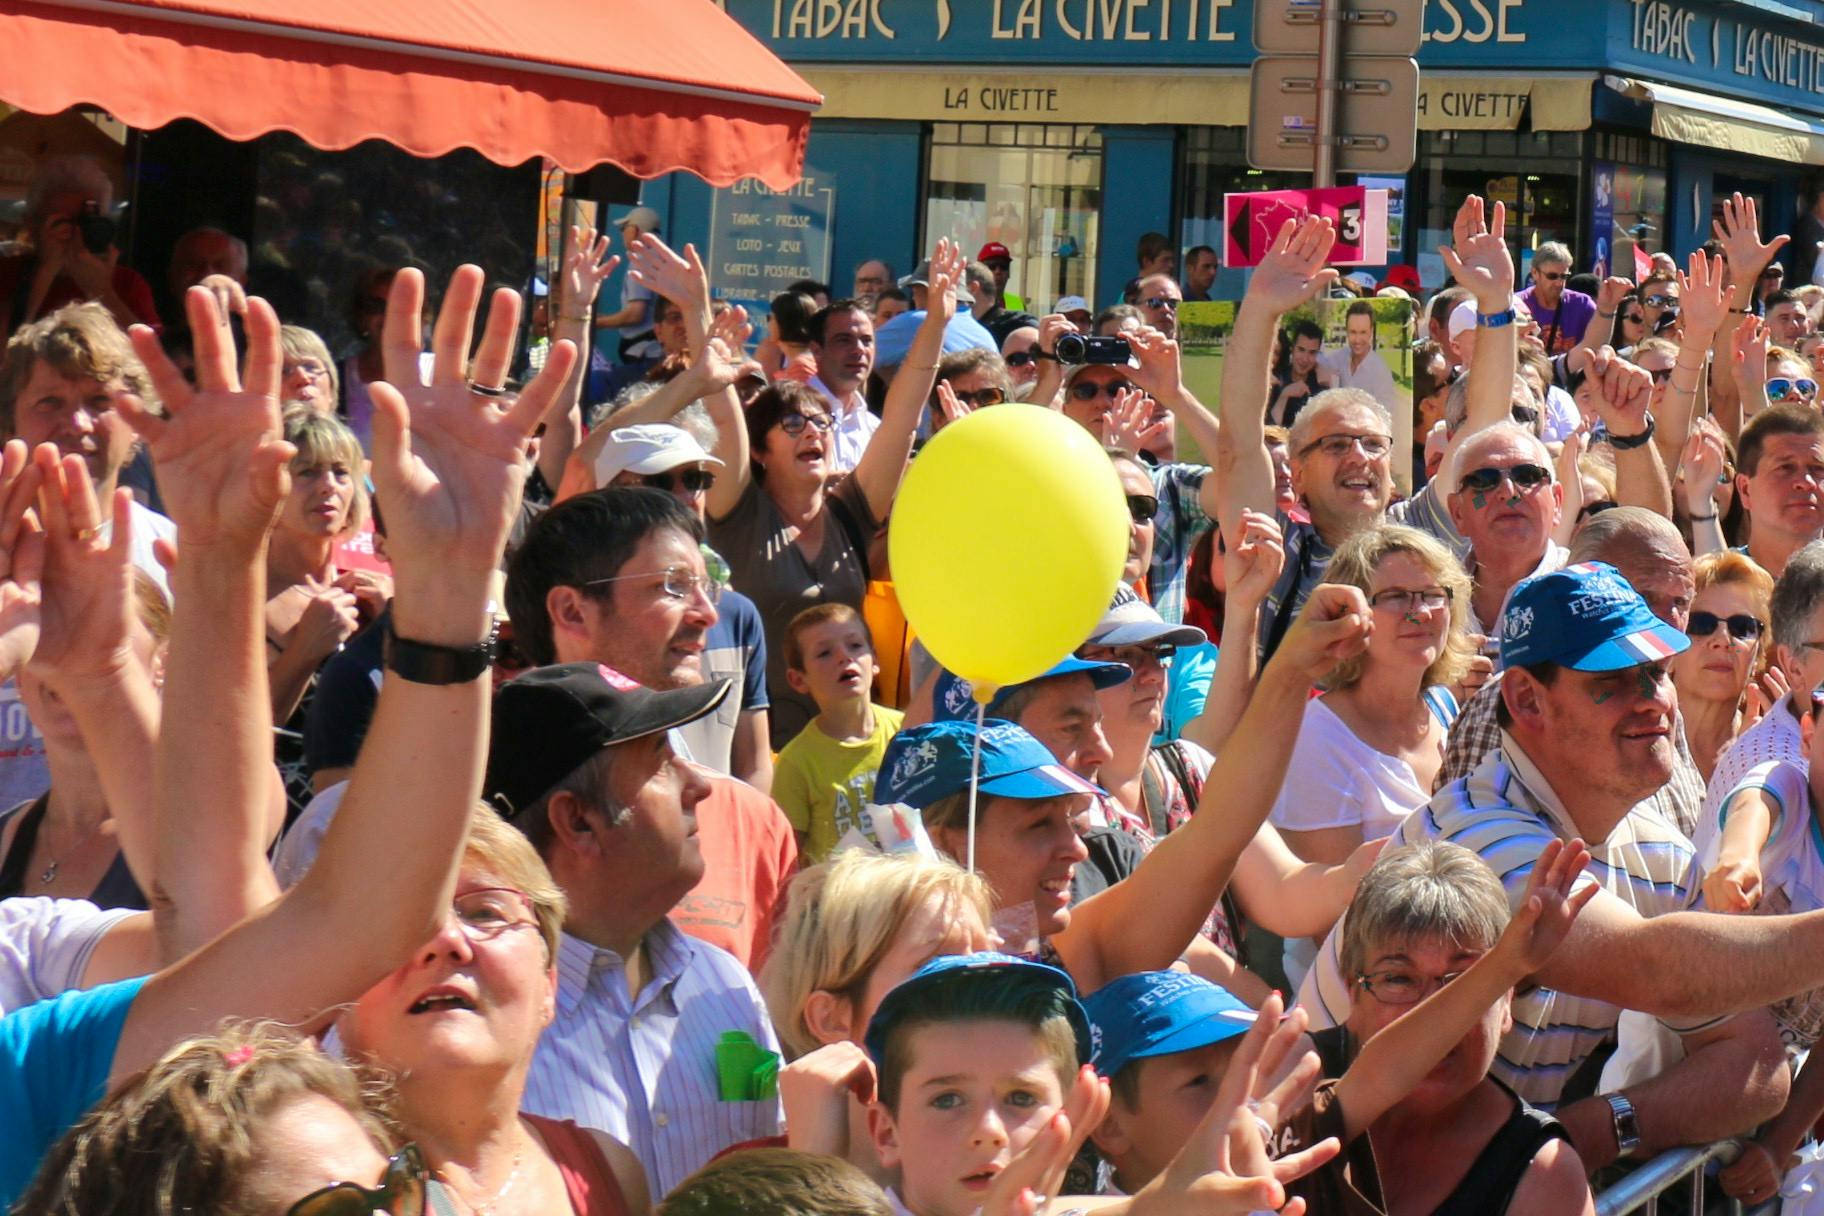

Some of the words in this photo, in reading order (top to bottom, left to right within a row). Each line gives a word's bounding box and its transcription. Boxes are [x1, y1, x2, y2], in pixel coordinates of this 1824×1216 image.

[1735, 23, 1757, 77] LA
[945, 88, 968, 110] LA
[980, 88, 1059, 112] CIVETTE
[775, 214, 811, 228] PRESSE
[1342, 208, 1360, 241] 3
[736, 239, 762, 252] LOTO
[777, 240, 802, 253] JEUX
[723, 263, 759, 276] CARTES
[764, 265, 812, 278] POSTALES
